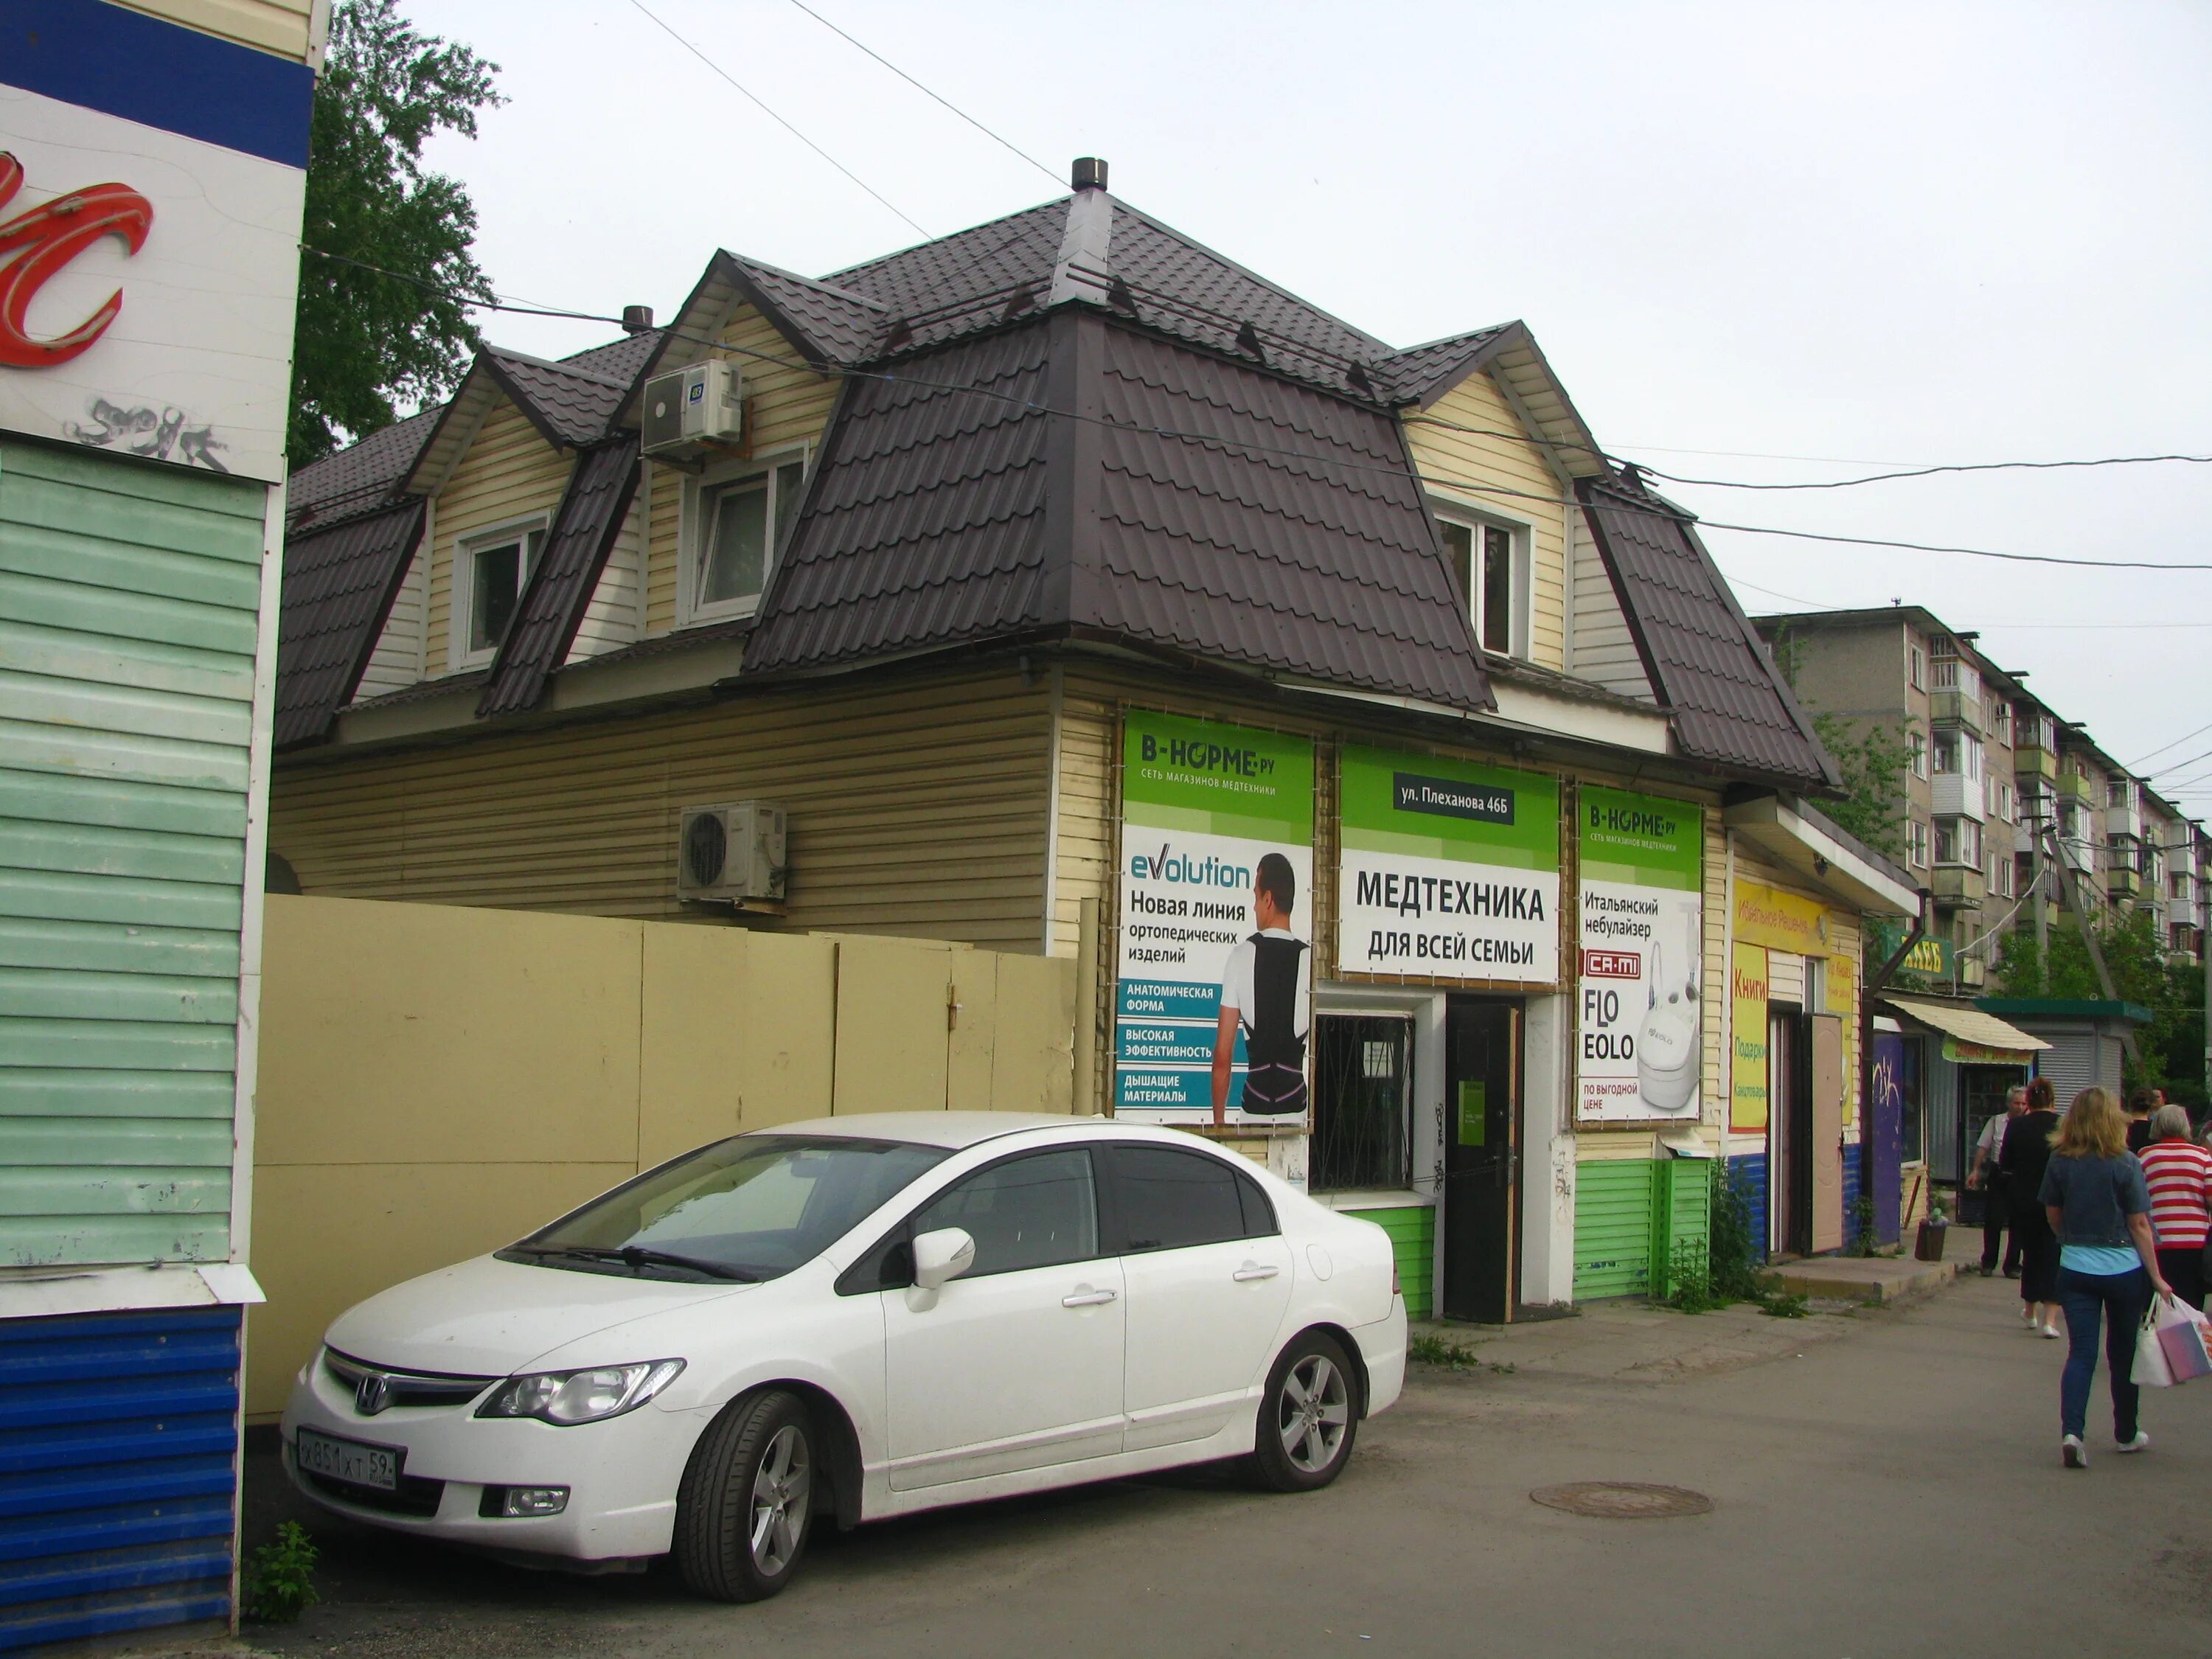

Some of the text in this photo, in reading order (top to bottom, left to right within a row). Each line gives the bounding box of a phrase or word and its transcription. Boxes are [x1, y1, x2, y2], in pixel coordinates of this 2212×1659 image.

[1141, 768, 1276, 796] СЕТЬ МАГАЗИНОВ МЕДТЕХНИКИ
[1401, 787, 1508, 813] ул. Плеханова 46Б
[1130, 890, 1245, 922] Новая линия
[1357, 871, 1545, 922] МЕДТЕХНИКА
[1585, 891, 1658, 916] Итальянский
[1129, 924, 1238, 944] ортопедических
[1585, 917, 1651, 942] небулайзер
[1128, 947, 1186, 964] изделий
[1368, 931, 1533, 965] ДЛЯ ВСЕЙ СЕМЬИ
[1127, 984, 1214, 999] АНАТОМИЧЕСКАЯ
[1735, 968, 1765, 1002] Книги
[1127, 999, 1164, 1012] ФОРМА
[1585, 990, 1618, 1027] FLO
[1125, 1029, 1175, 1041] ВЫСОКАЯ
[1585, 1034, 1634, 1060] EOLO
[1125, 1044, 1211, 1058] ЭФФЕКТИВНОСТЬ
[1124, 1075, 1180, 1088] ДЫШАЩИЕ
[1584, 1083, 1638, 1096] ПО ВЫГОДНОЙ
[1124, 1091, 1186, 1102] МАТЕРИАЛЫ
[1584, 1099, 1603, 1110] ЦЕНЕ
[370, 1451, 388, 1476] 59
